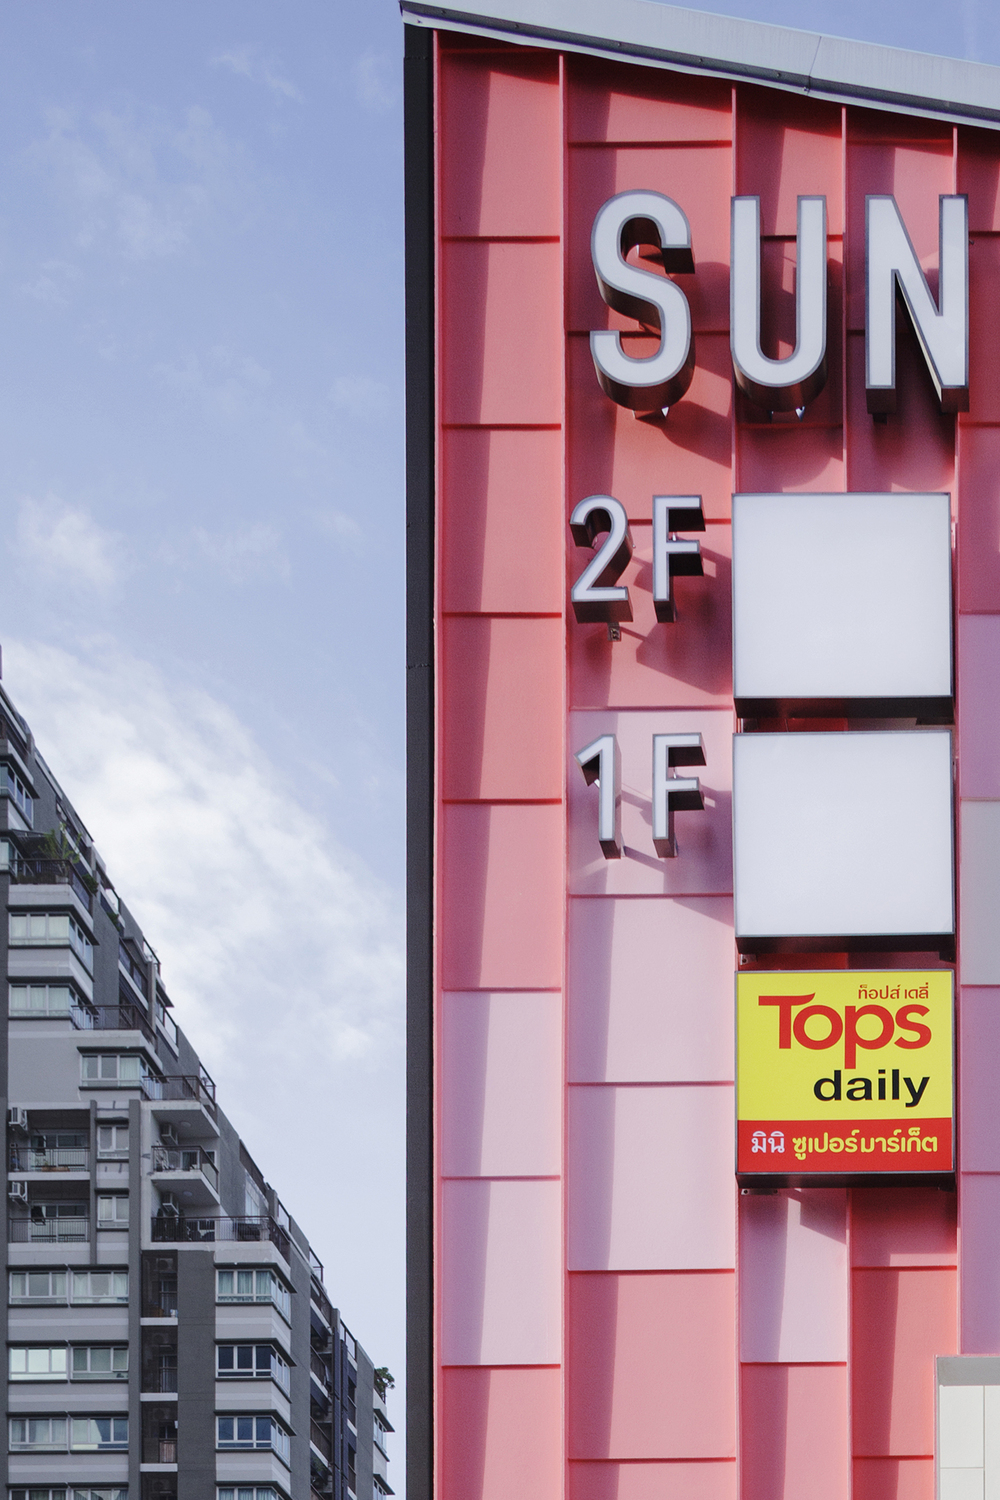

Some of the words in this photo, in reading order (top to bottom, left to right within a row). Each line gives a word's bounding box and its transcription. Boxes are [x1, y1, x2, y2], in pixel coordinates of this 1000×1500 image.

[589, 189, 970, 392] SUN
[569, 494, 703, 602] 2F
[574, 732, 703, 841] 1F
[858, 984, 901, 1000] ท็อปส์
[904, 982, 929, 999] เดลี่
[758, 992, 932, 1069] Tops
[813, 1069, 930, 1107] daily
[751, 1130, 785, 1153] มินิ
[792, 1127, 938, 1160] ซูเปอร์มาร์เก็ต
